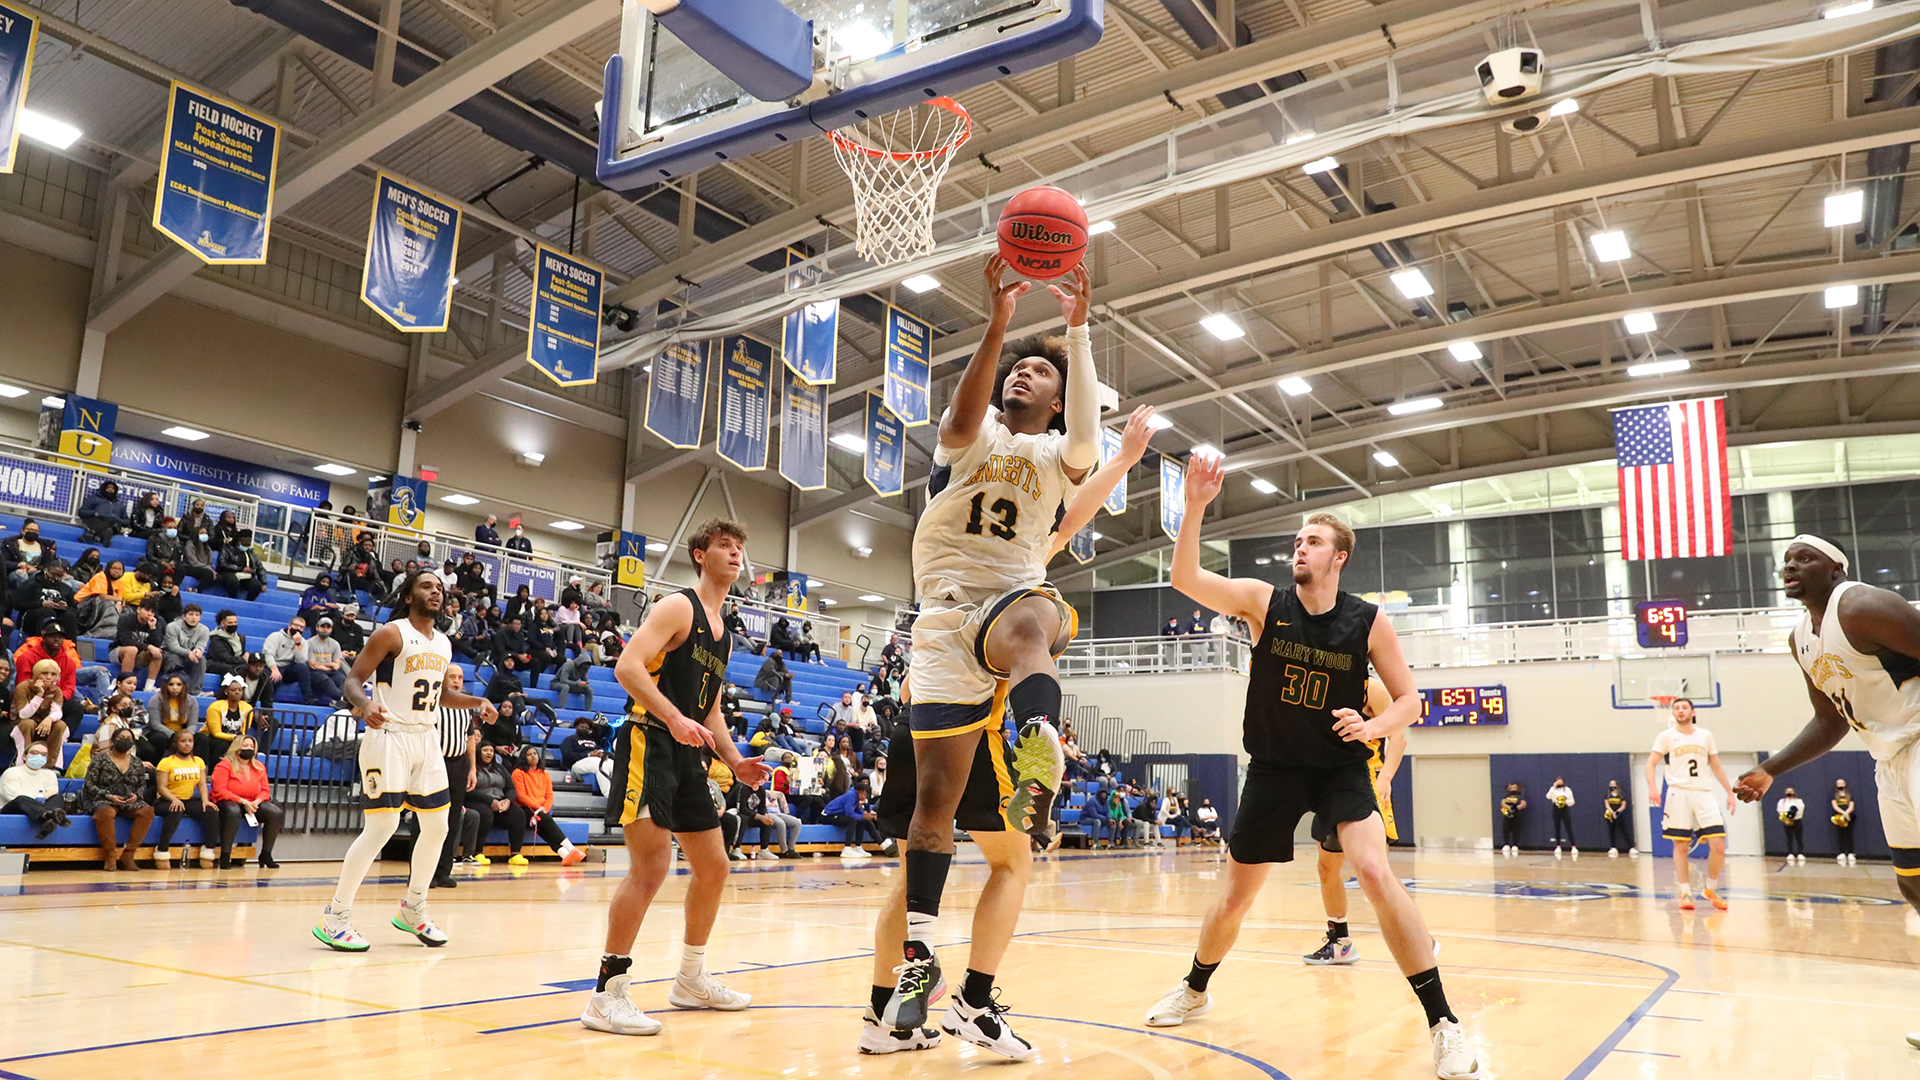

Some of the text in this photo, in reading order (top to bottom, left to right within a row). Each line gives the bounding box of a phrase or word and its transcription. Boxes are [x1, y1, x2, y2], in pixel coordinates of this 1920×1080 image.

[188, 100, 263, 142] FIELD HOCKEY
[192, 132, 253, 163] Appearances
[195, 122, 253, 153] Post-Season
[174, 140, 266, 181] NCAA Tournament Appearance
[170, 180, 262, 219] ECAC Tournament Appearance
[387, 186, 451, 226] MEN'S SOCCER
[396, 207, 439, 233] Conference
[396, 217, 436, 241] Champions
[403, 236, 422, 249] 2010
[1011, 221, 1073, 245] Wilson
[401, 260, 418, 275] 2014
[545, 255, 596, 287] MEN'S SOCCER
[1016, 254, 1062, 270] NCAA
[77, 406, 103, 432] N
[76, 433, 101, 457] U
[0, 465, 58, 501] HOME
[156, 454, 234, 482] UNIVERSITY
[236, 472, 269, 489] HALL
[271, 481, 288, 494] OF
[289, 484, 321, 501] FAME
[87, 478, 164, 502] SCTION
[965, 490, 1018, 541] 13
[627, 539, 640, 557] N
[509, 563, 555, 581] SECTION
[626, 558, 638, 575] U
[1647, 606, 1685, 623] 6:57
[1661, 624, 1676, 643] 4
[1271, 637, 1352, 671] MARYWOOD
[411, 678, 442, 712] 23
[698, 672, 711, 710] 1
[1281, 664, 1330, 710] 30
[1441, 688, 1476, 706] 6:57
[1469, 711, 1478, 725] 2
[1482, 697, 1504, 715] 49
[1444, 714, 1465, 724] period
[1688, 758, 1699, 777] 2
